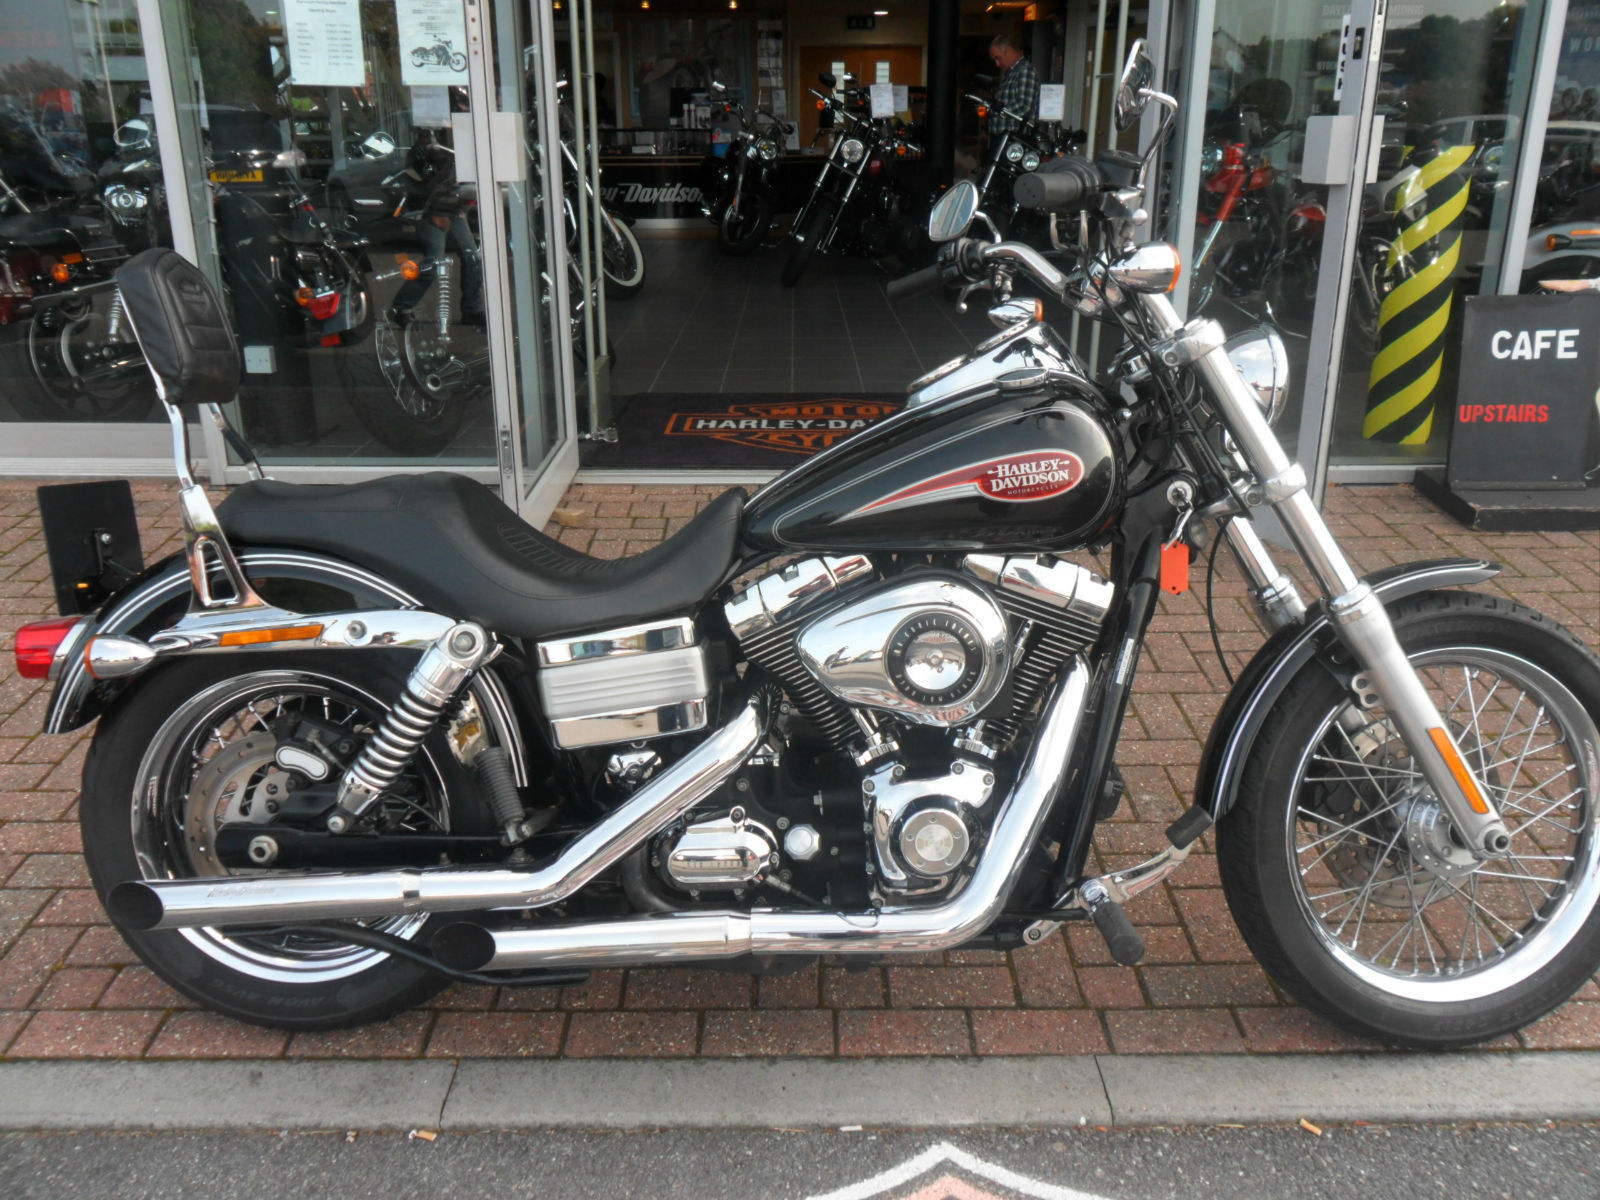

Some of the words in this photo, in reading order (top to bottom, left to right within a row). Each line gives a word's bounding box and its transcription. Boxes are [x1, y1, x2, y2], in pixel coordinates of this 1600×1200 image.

[600, 183, 704, 203] ey-Davidso
[1491, 329, 1580, 360] CAFE
[1459, 404, 1549, 423] UPSTAIRS
[696, 419, 873, 430] HARLEY-DA
[996, 459, 1061, 478] HARLEY
[990, 469, 1070, 492] DAVIDSON
